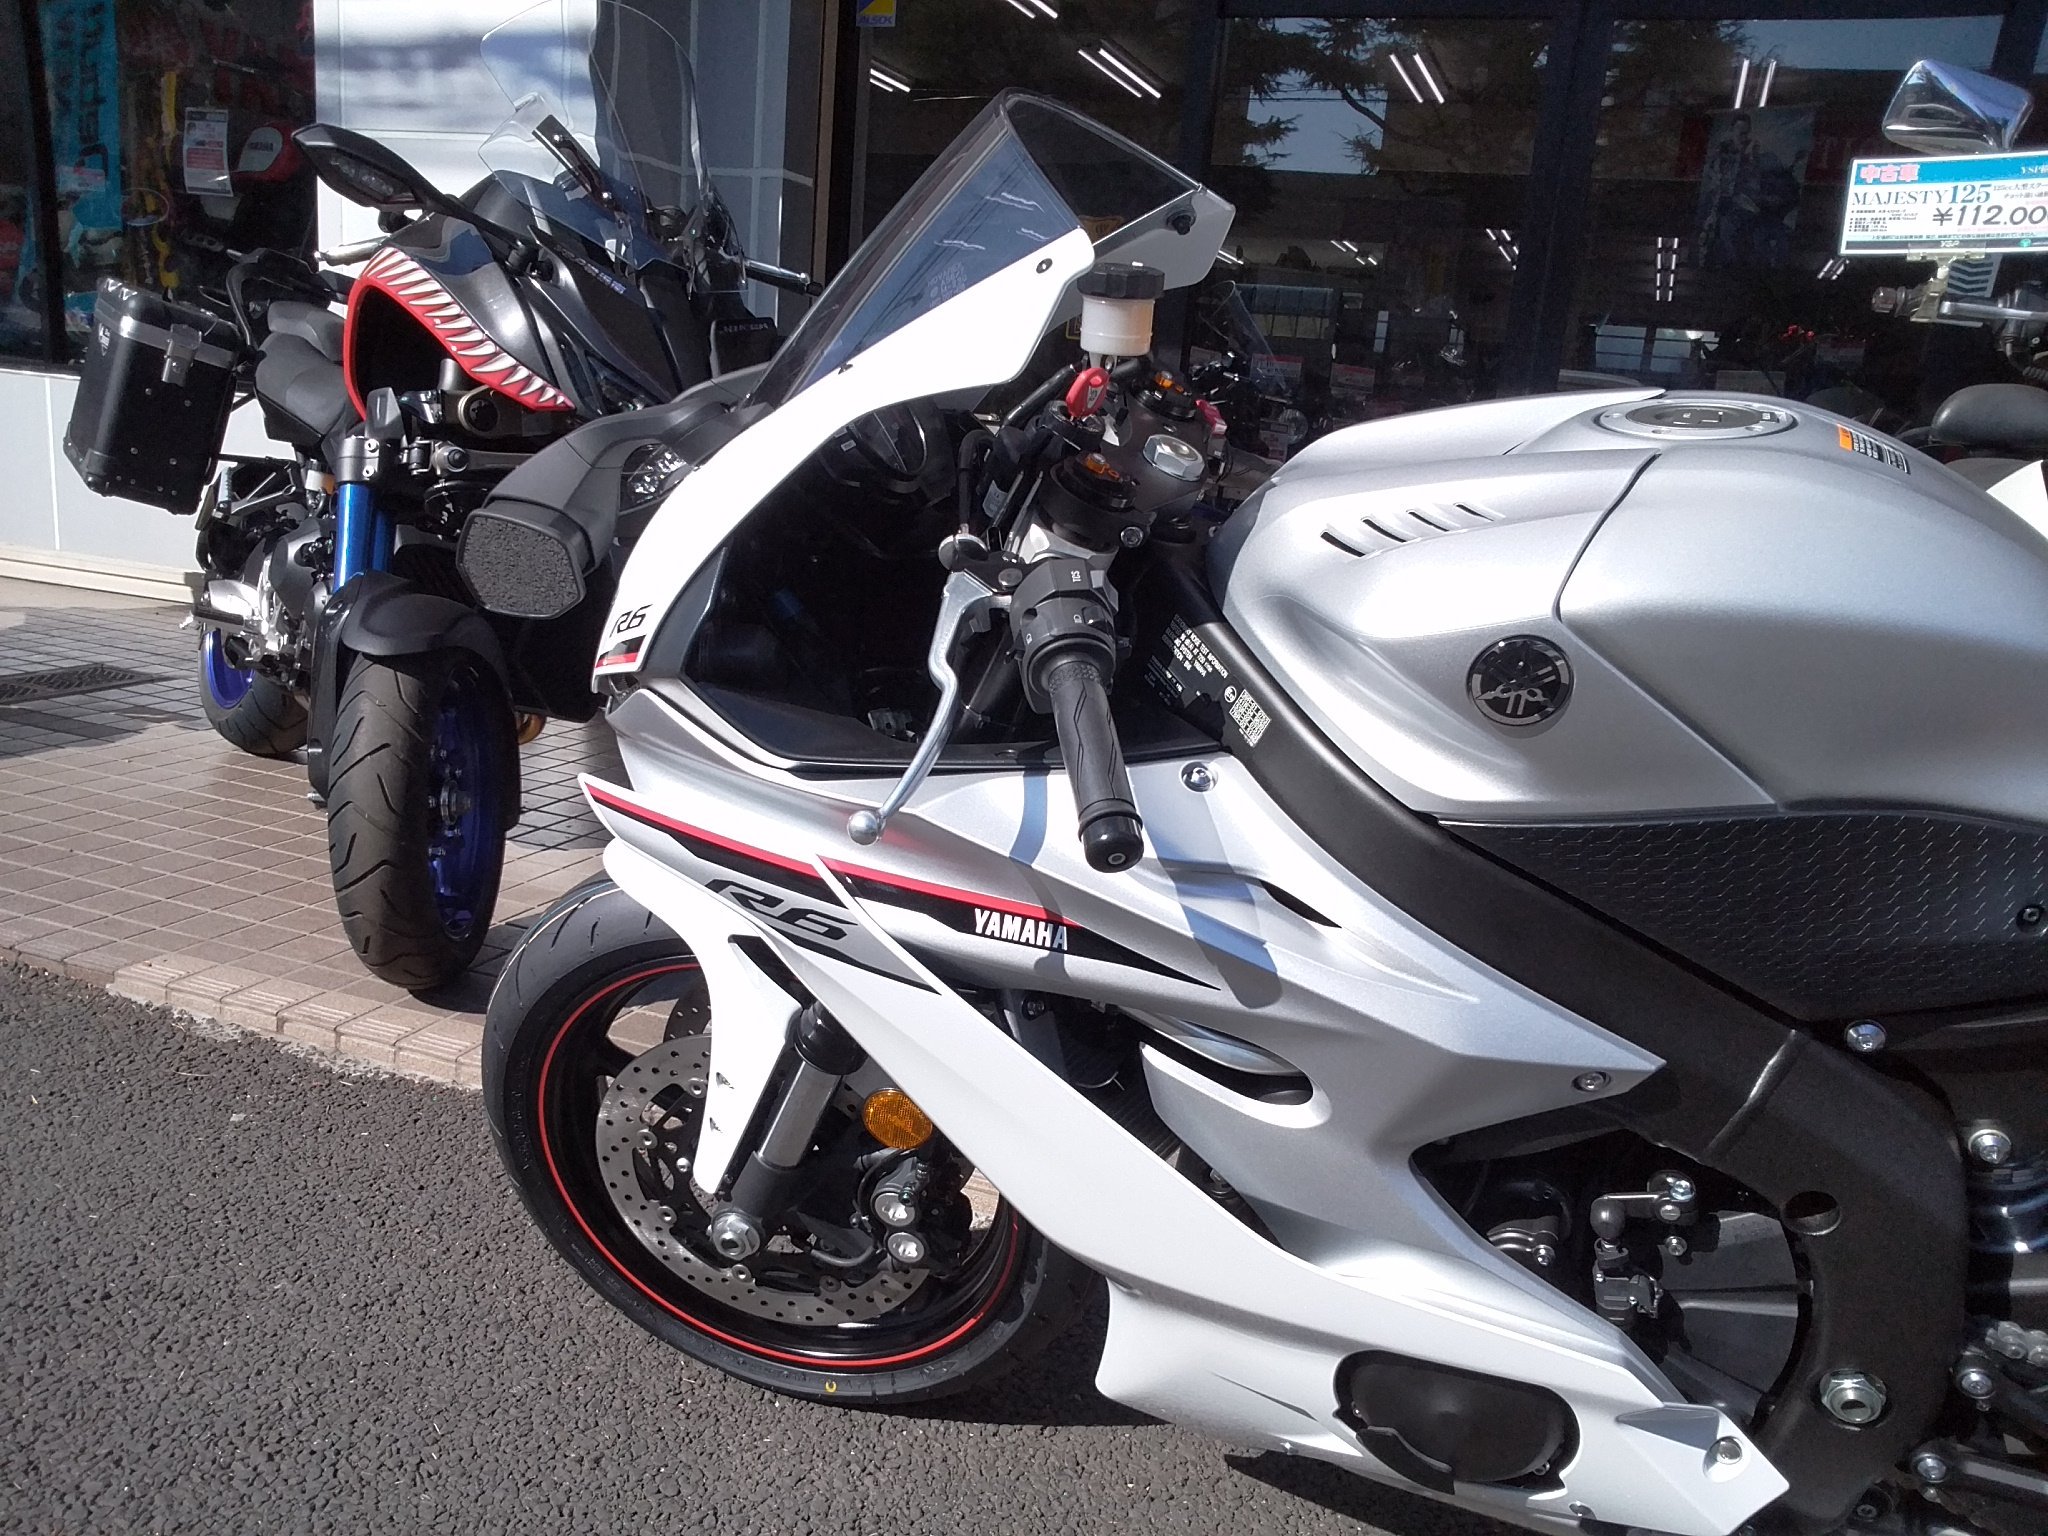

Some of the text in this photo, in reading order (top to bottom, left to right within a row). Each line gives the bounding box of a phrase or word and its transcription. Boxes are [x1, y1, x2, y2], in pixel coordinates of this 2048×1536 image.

[1860, 164, 1920, 183] 中古車
[1933, 204, 2048, 227] ¥112.00
[609, 603, 654, 638] R6
[704, 878, 859, 941] R6
[973, 907, 1069, 951] YAMAHA
